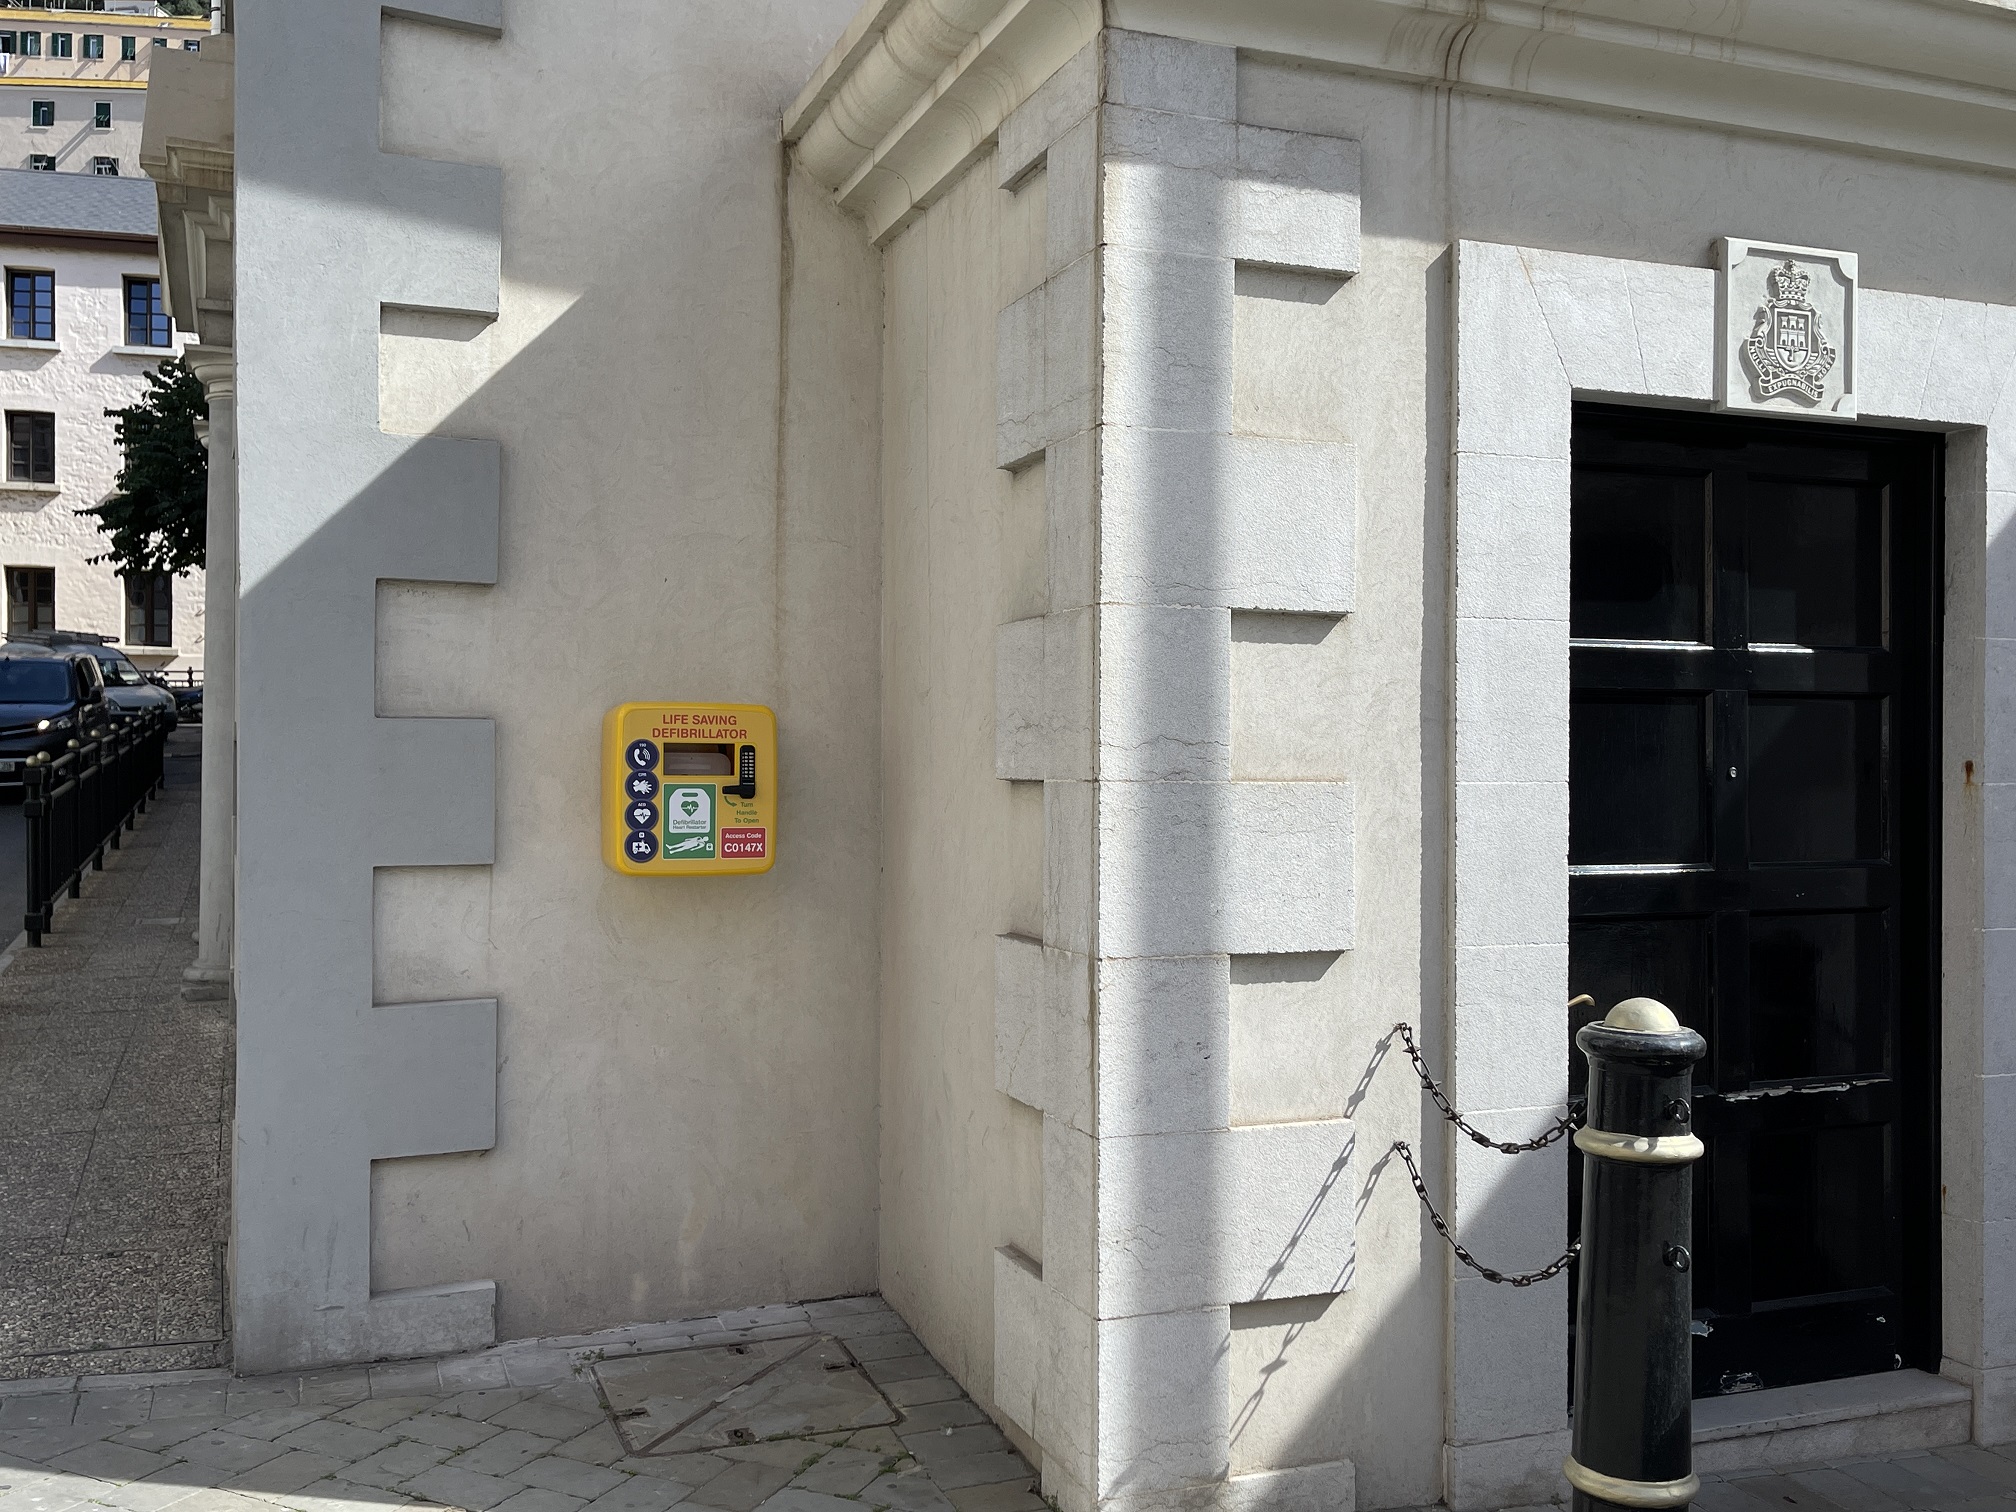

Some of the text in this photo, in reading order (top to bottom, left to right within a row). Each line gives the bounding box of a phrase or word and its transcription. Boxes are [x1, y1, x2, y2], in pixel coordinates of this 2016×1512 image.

[1767, 379, 1819, 399] EXPUGNABILIS
[663, 714, 737, 726] LIFE SAVING
[652, 728, 747, 739] DEFIBRILLATOR
